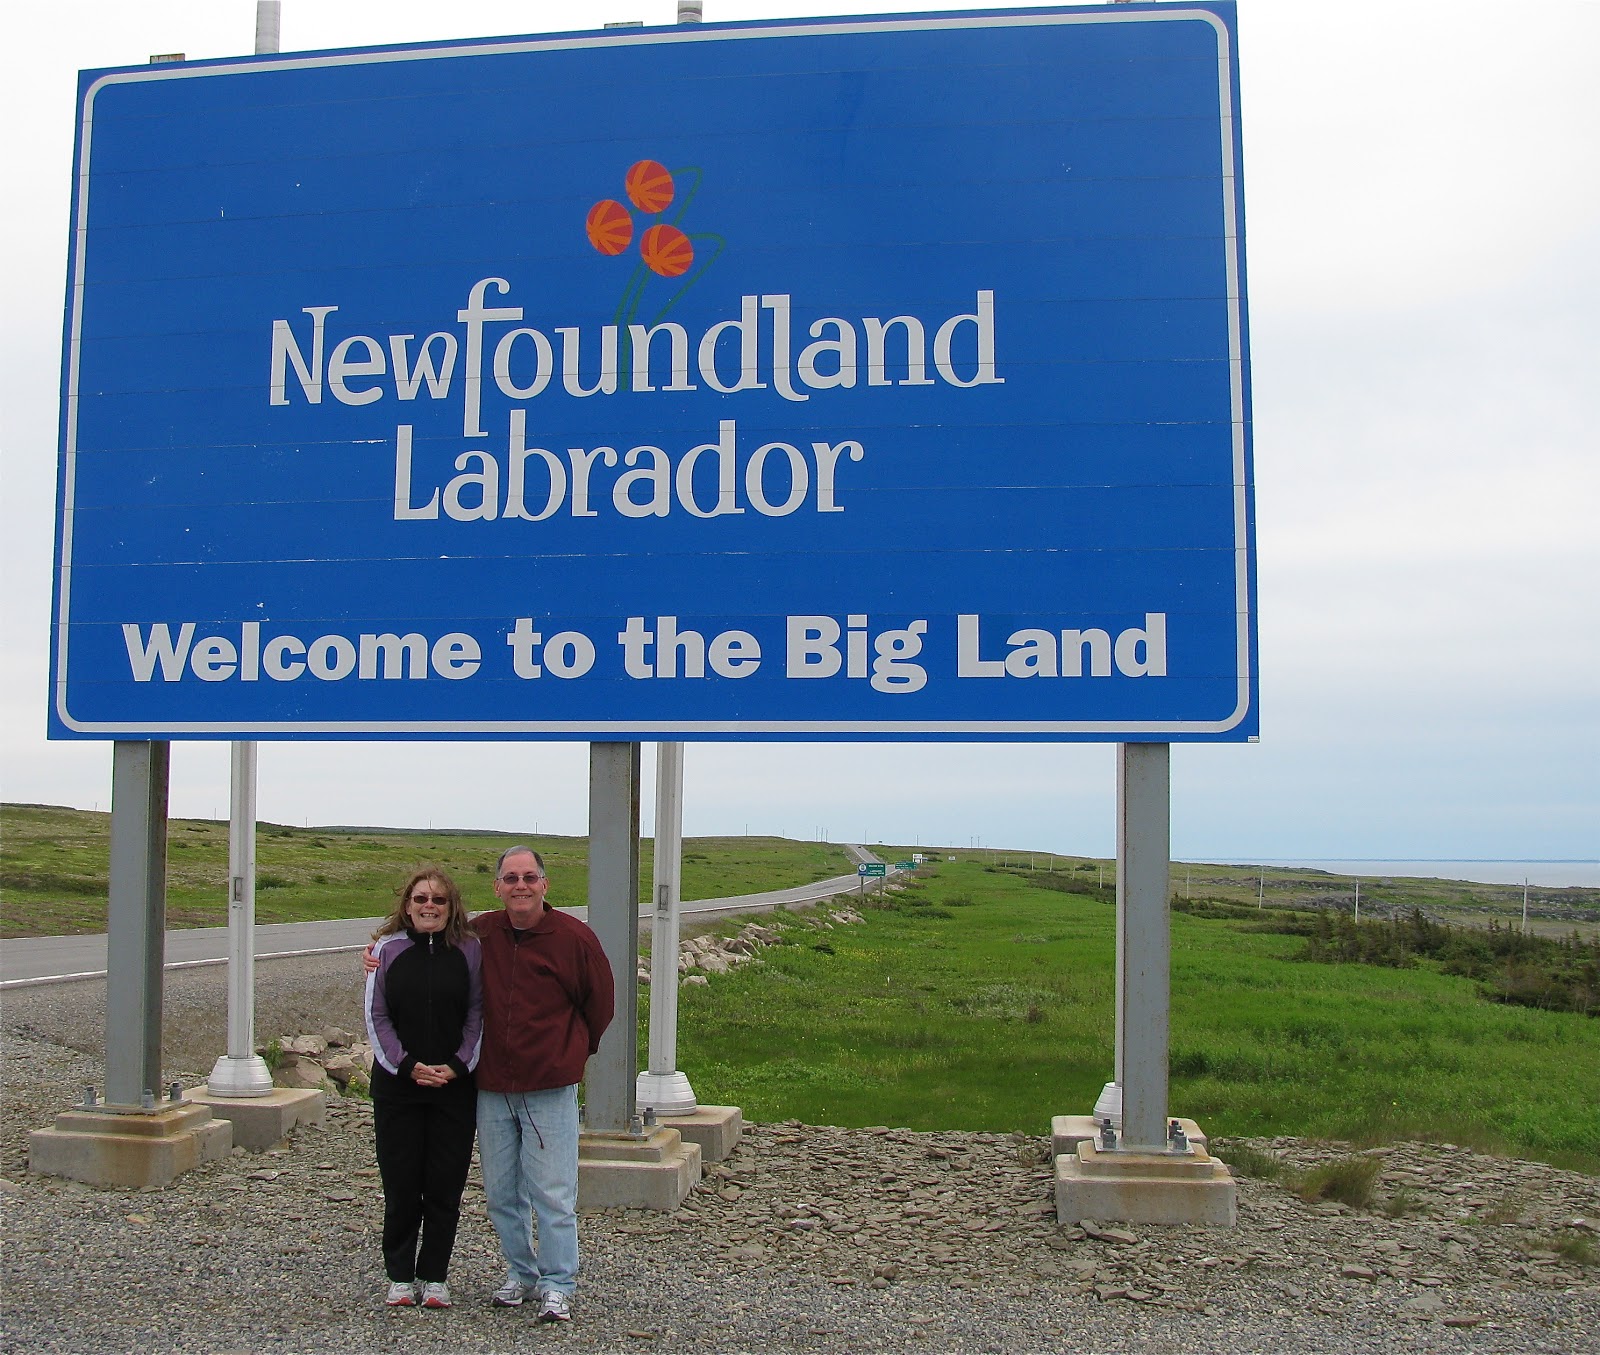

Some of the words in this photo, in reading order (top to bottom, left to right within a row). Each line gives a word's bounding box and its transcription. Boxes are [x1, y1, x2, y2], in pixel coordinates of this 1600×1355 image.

[269, 277, 1005, 438] Newfoundland
[393, 408, 864, 521] Labrador
[121, 621, 482, 682] Welcome
[506, 617, 596, 680] to
[617, 615, 761, 679] the
[786, 614, 928, 694] Big
[957, 612, 1167, 678] Land
